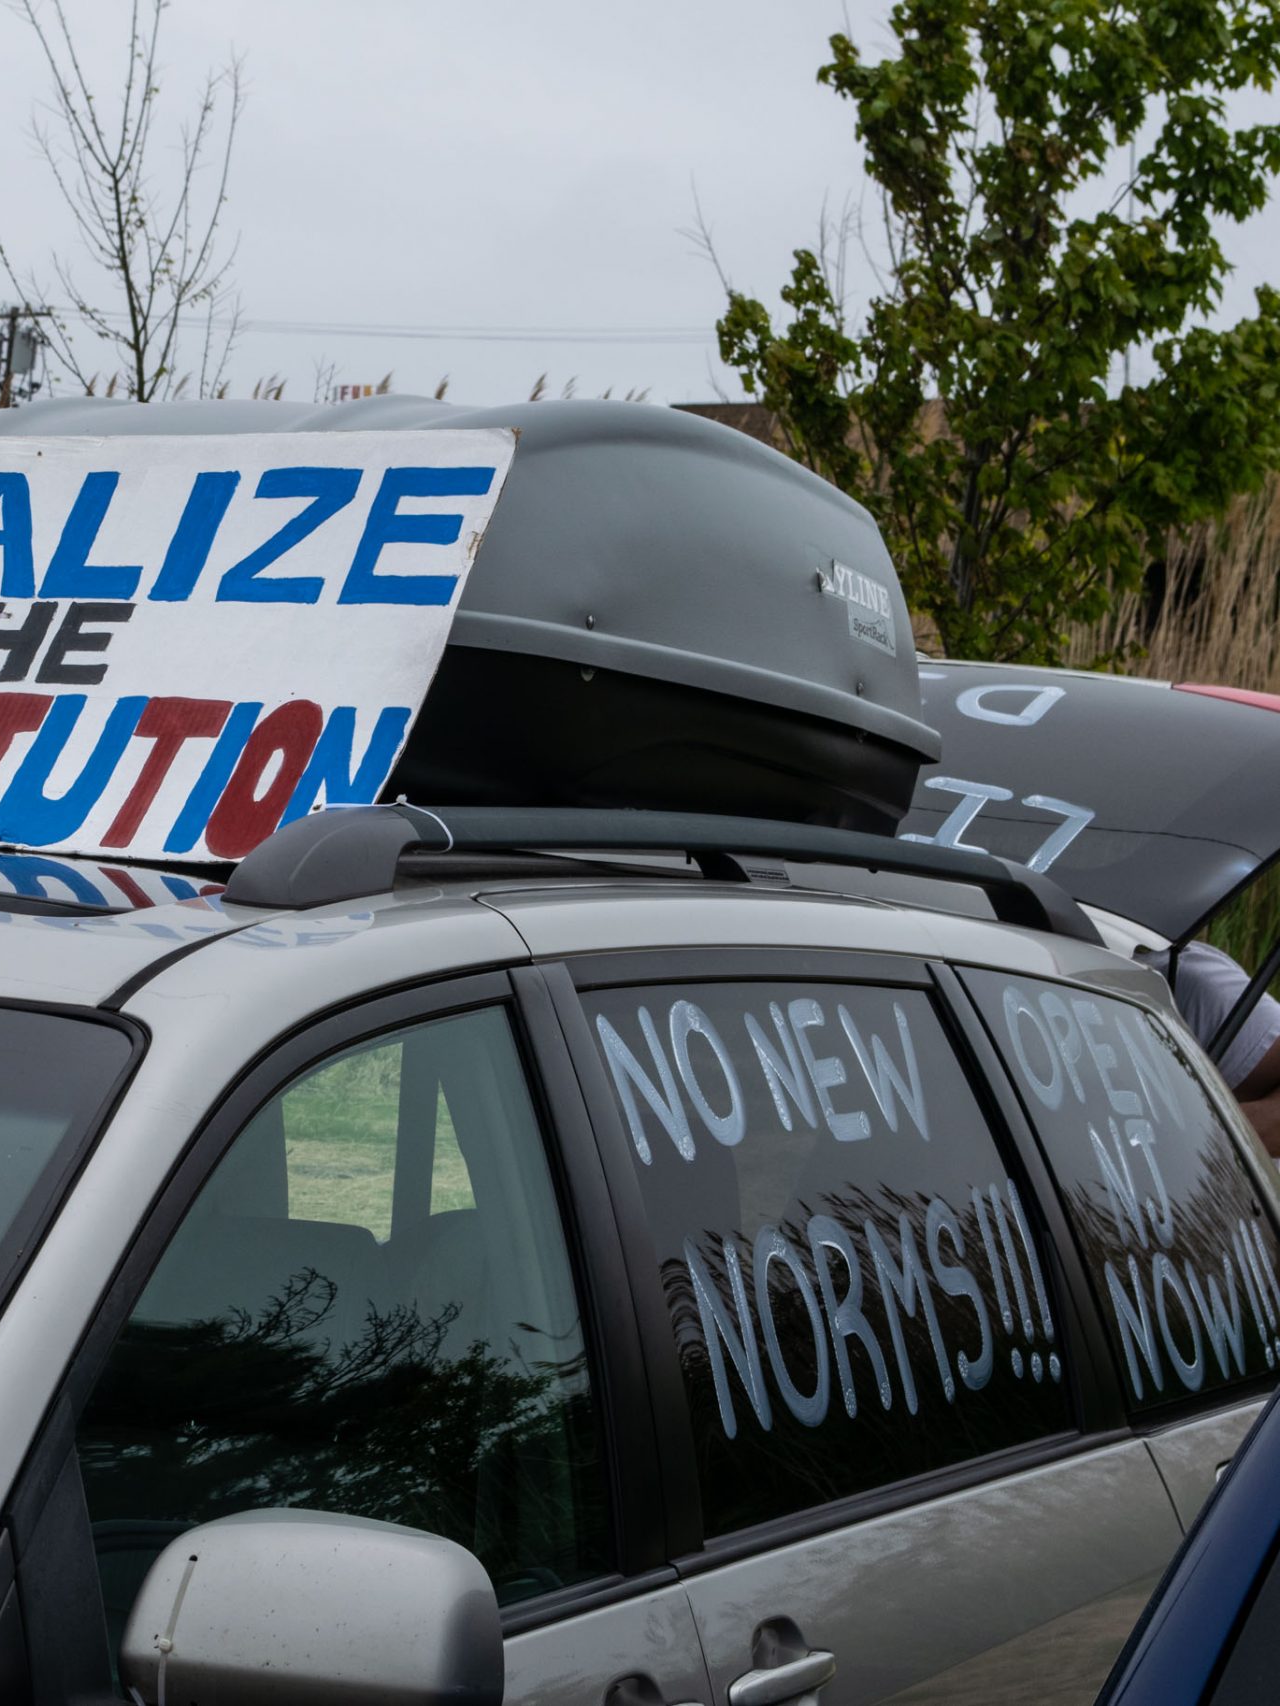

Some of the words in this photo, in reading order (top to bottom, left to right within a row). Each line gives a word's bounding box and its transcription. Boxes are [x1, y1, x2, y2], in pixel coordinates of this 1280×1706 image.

[596, 1000, 745, 1166] NO
[745, 998, 930, 1141] NEW
[1002, 985, 1186, 1131] OPEN
[1087, 1116, 1175, 1249] NJ
[682, 1179, 1061, 1440] NORMS!!!
